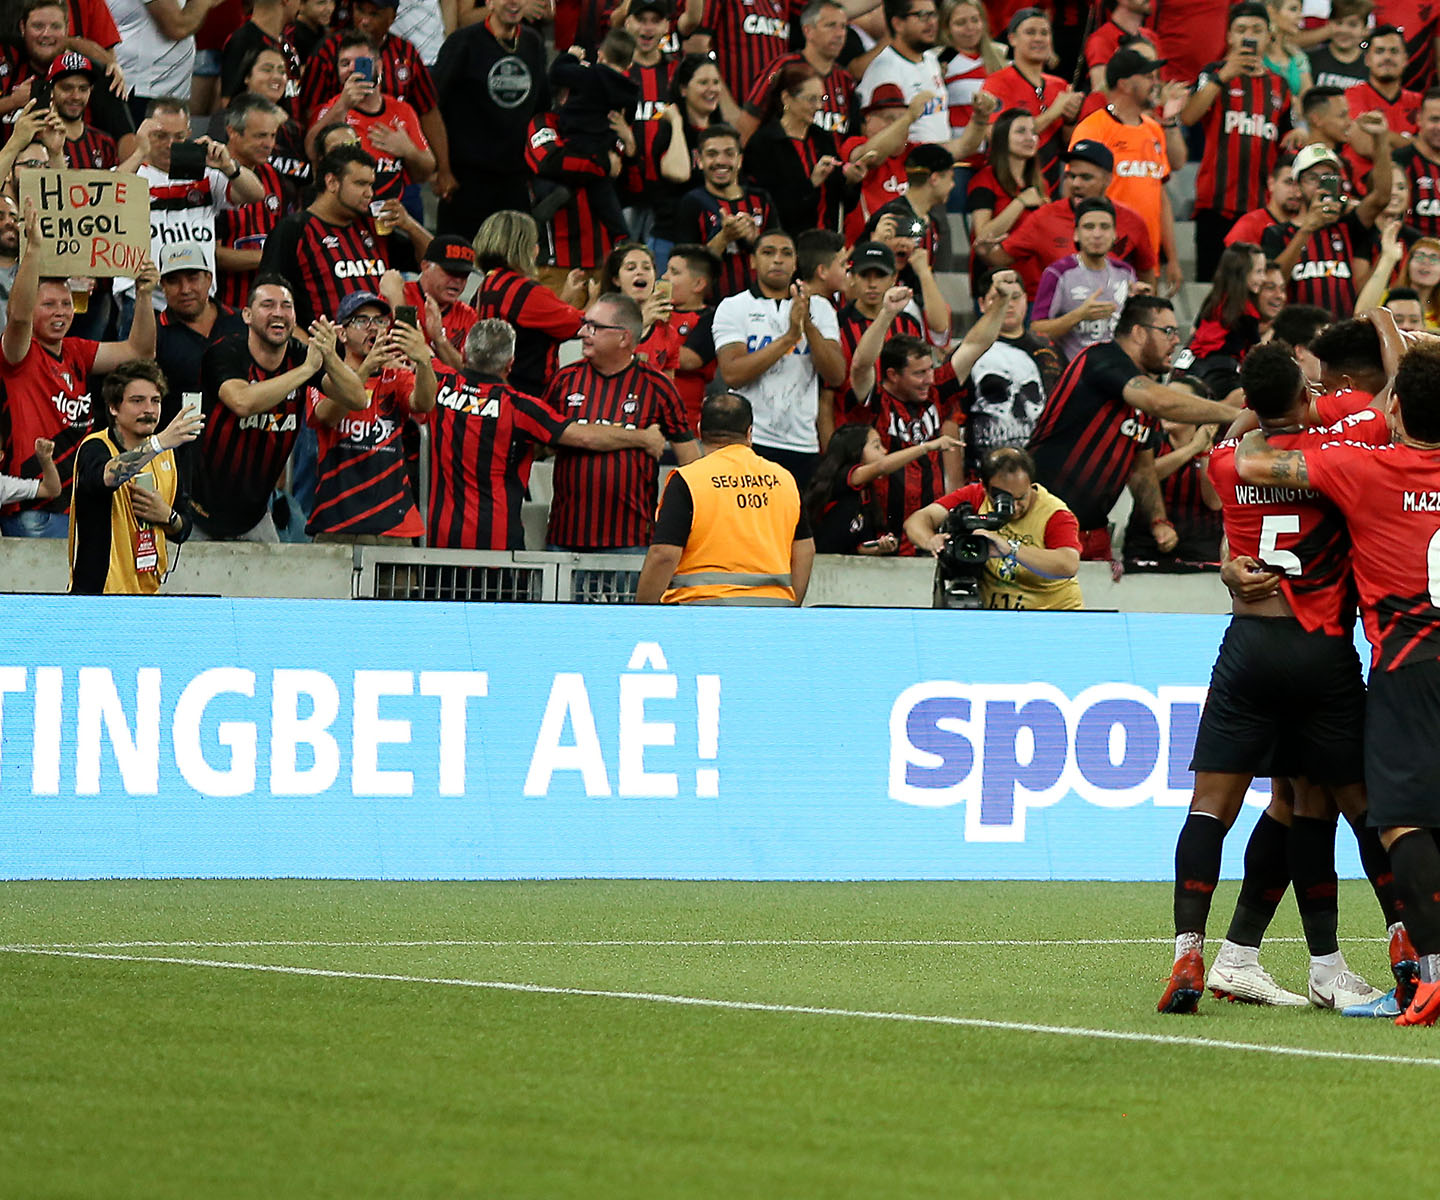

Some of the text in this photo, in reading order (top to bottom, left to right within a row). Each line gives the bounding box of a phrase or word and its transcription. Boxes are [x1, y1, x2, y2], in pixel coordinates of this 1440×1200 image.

[812, 109, 850, 134] AIXA
[268, 155, 310, 178] AIXA
[40, 173, 127, 211] HOJE
[56, 239, 80, 256] DO
[90, 237, 146, 273] RONY
[334, 258, 387, 279] CAIXA
[1291, 260, 1351, 281] CAIXA
[436, 385, 500, 418] CAIXA
[1257, 514, 1303, 577] 5
[523, 642, 722, 799] AÊ!
